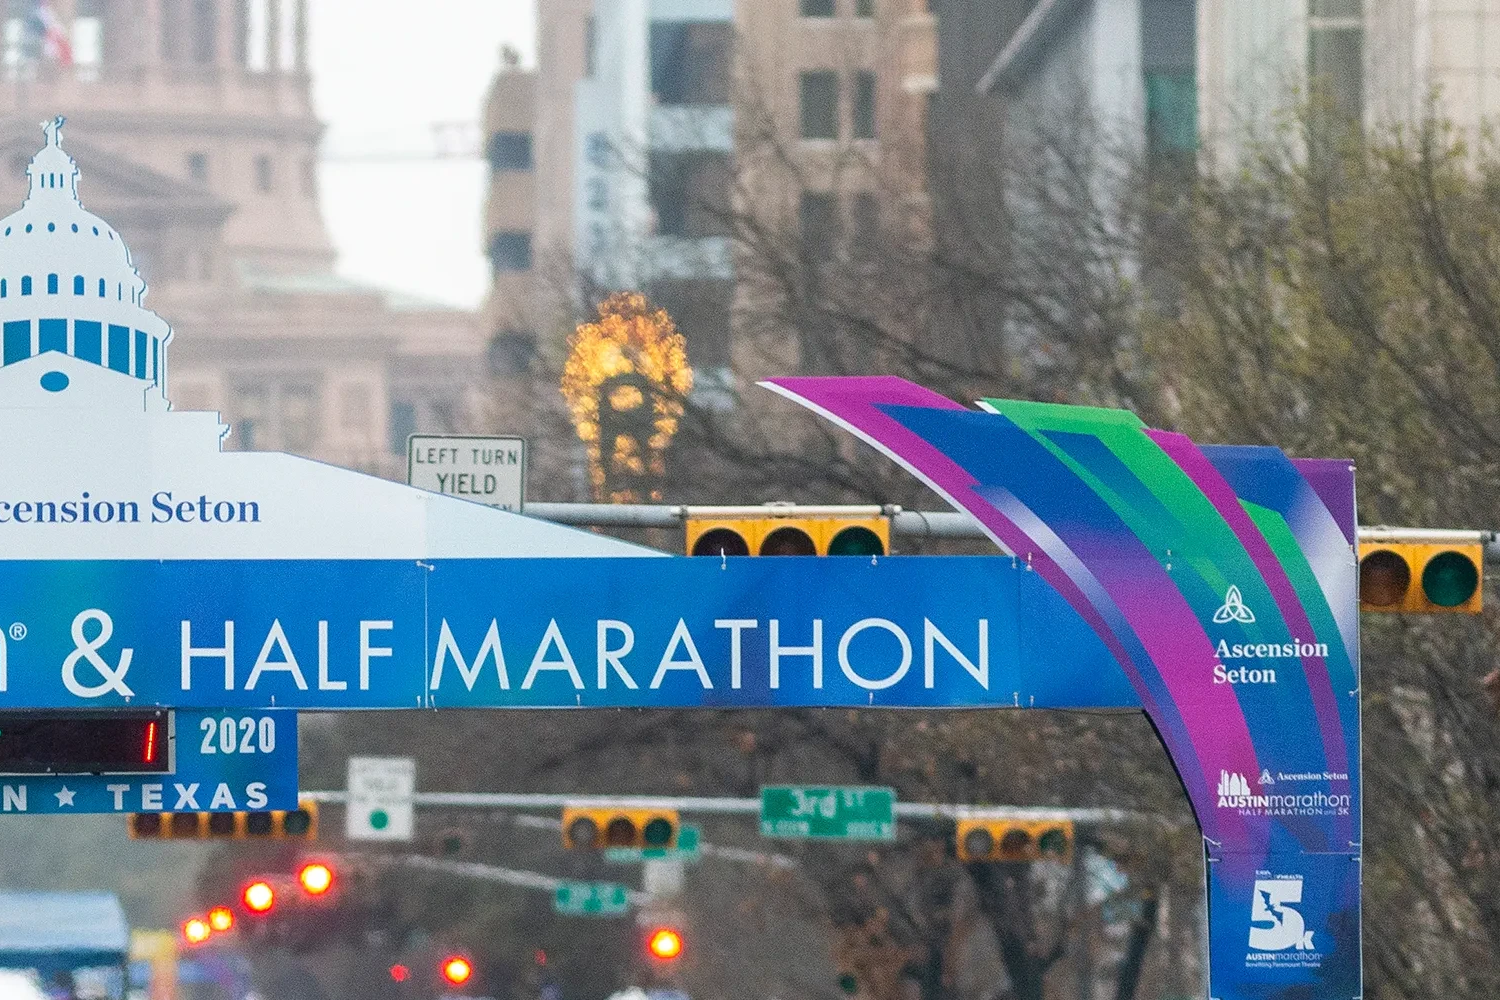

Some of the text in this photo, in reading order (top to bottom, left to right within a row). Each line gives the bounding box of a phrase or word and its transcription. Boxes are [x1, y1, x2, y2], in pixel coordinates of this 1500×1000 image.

[415, 448, 518, 465] LEFT TURN
[436, 473, 498, 494] YIELD
[151, 491, 261, 523] Seton
[61, 608, 136, 698] &
[180, 620, 393, 691] HALF
[430, 617, 990, 692] MARATHON
[1213, 637, 1329, 658] Ascension
[1213, 664, 1277, 684] Seton
[200, 716, 276, 755] 2020
[1277, 772, 1349, 781] Ascension Seton
[106, 782, 268, 811] TEXAS
[1239, 808, 1262, 816] HALF
[1265, 808, 1323, 816] MARATHON
